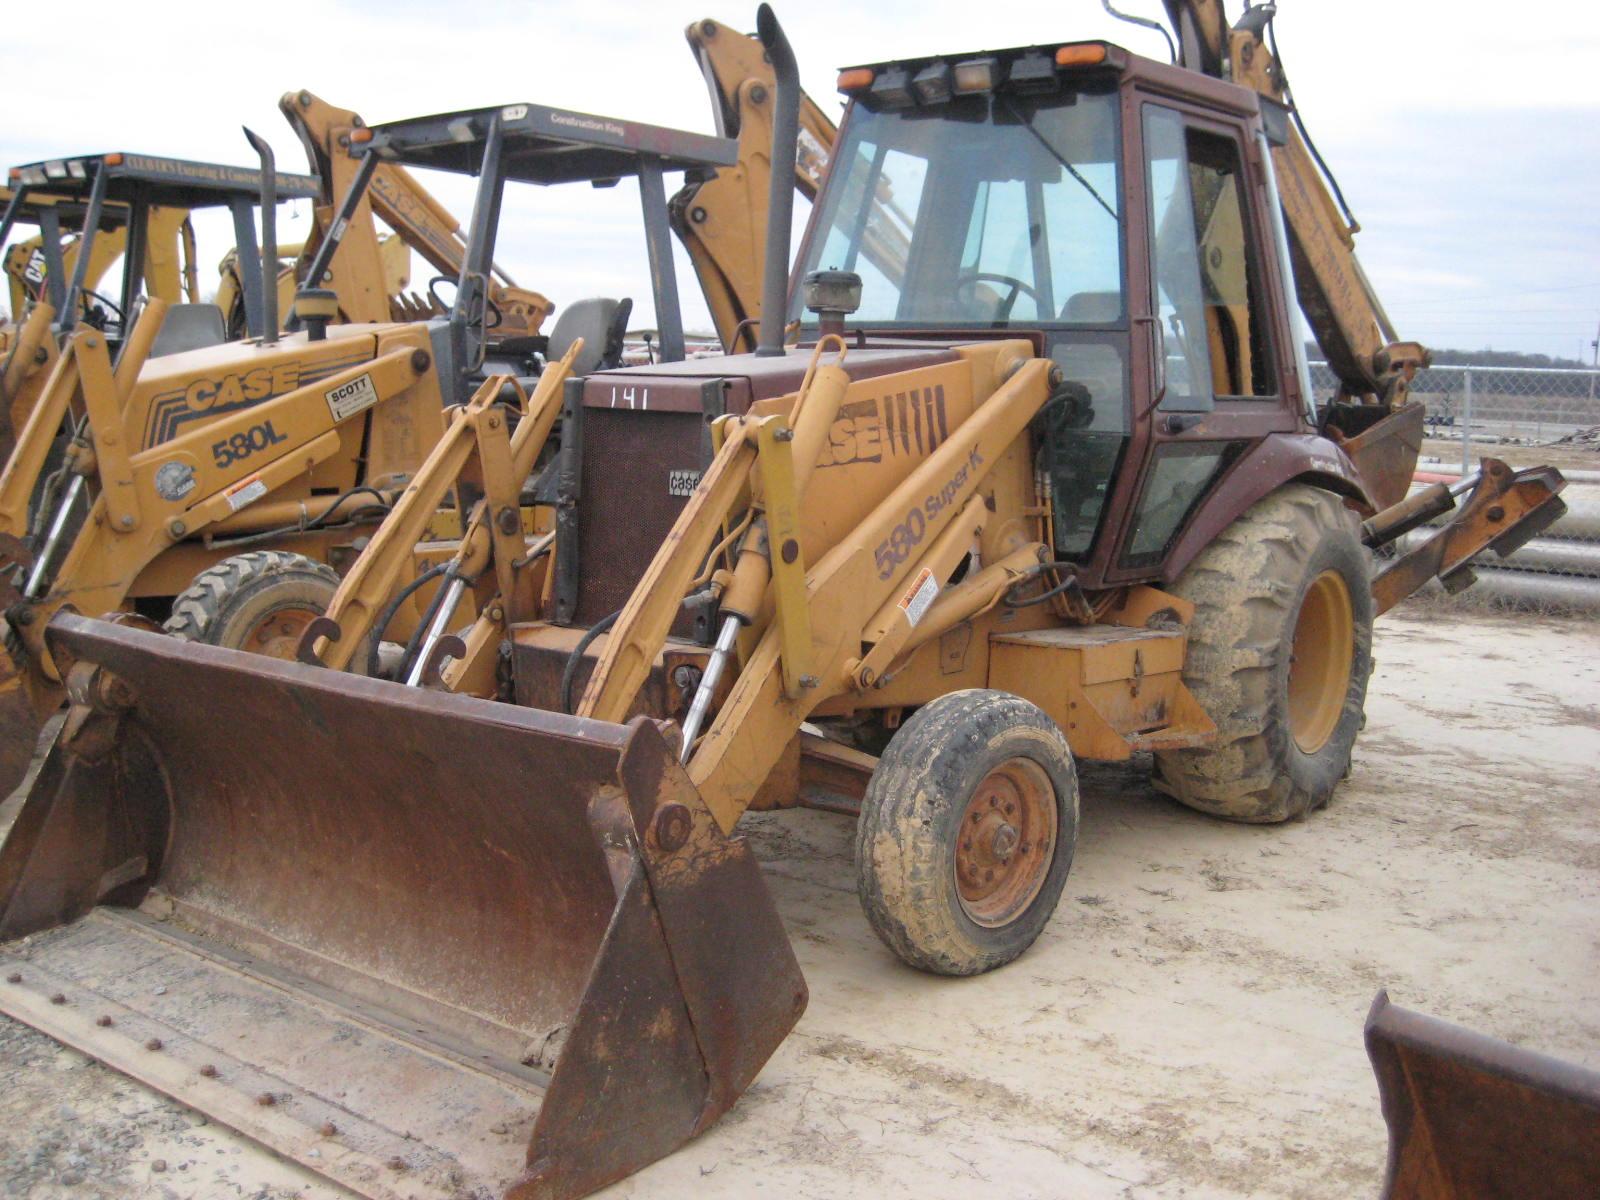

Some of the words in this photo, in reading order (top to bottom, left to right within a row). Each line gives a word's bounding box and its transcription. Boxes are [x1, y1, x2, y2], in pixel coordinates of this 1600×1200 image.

[551, 112, 604, 130] Construction
[605, 122, 625, 136] King
[25, 249, 46, 283] CAT
[185, 361, 300, 412] CASE
[331, 378, 366, 402] SCOTT
[611, 386, 648, 410] 141
[212, 420, 288, 469] 580L
[875, 507, 926, 581] 580
[925, 463, 969, 520] Super
[969, 443, 985, 471] K
